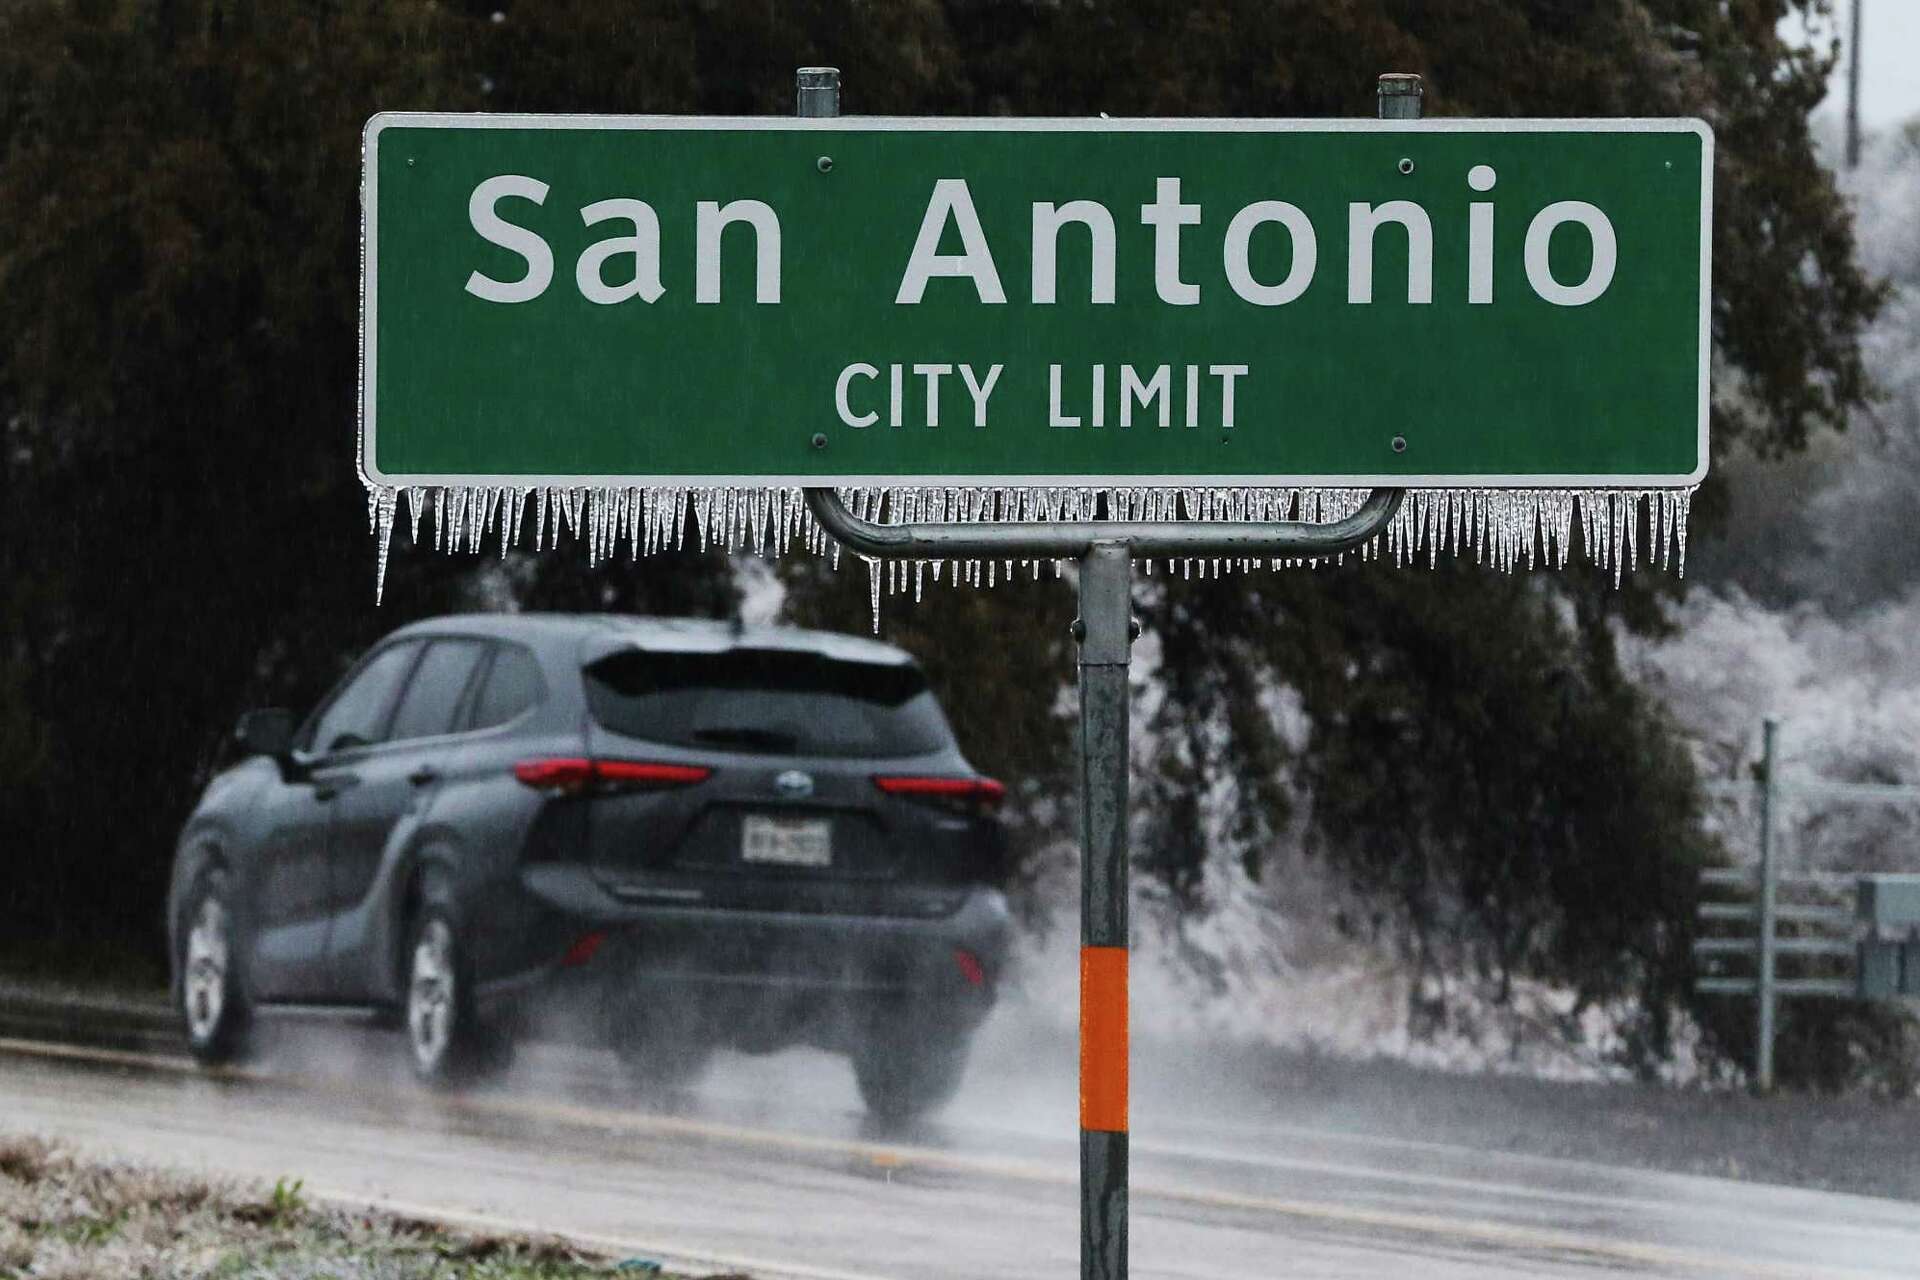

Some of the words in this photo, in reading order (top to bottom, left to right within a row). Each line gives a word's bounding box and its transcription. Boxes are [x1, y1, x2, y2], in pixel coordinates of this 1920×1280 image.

[464, 174, 781, 305] San
[895, 166, 1617, 306] Antonio
[835, 362, 1004, 428] CITY
[1049, 363, 1249, 428] LIMIT
